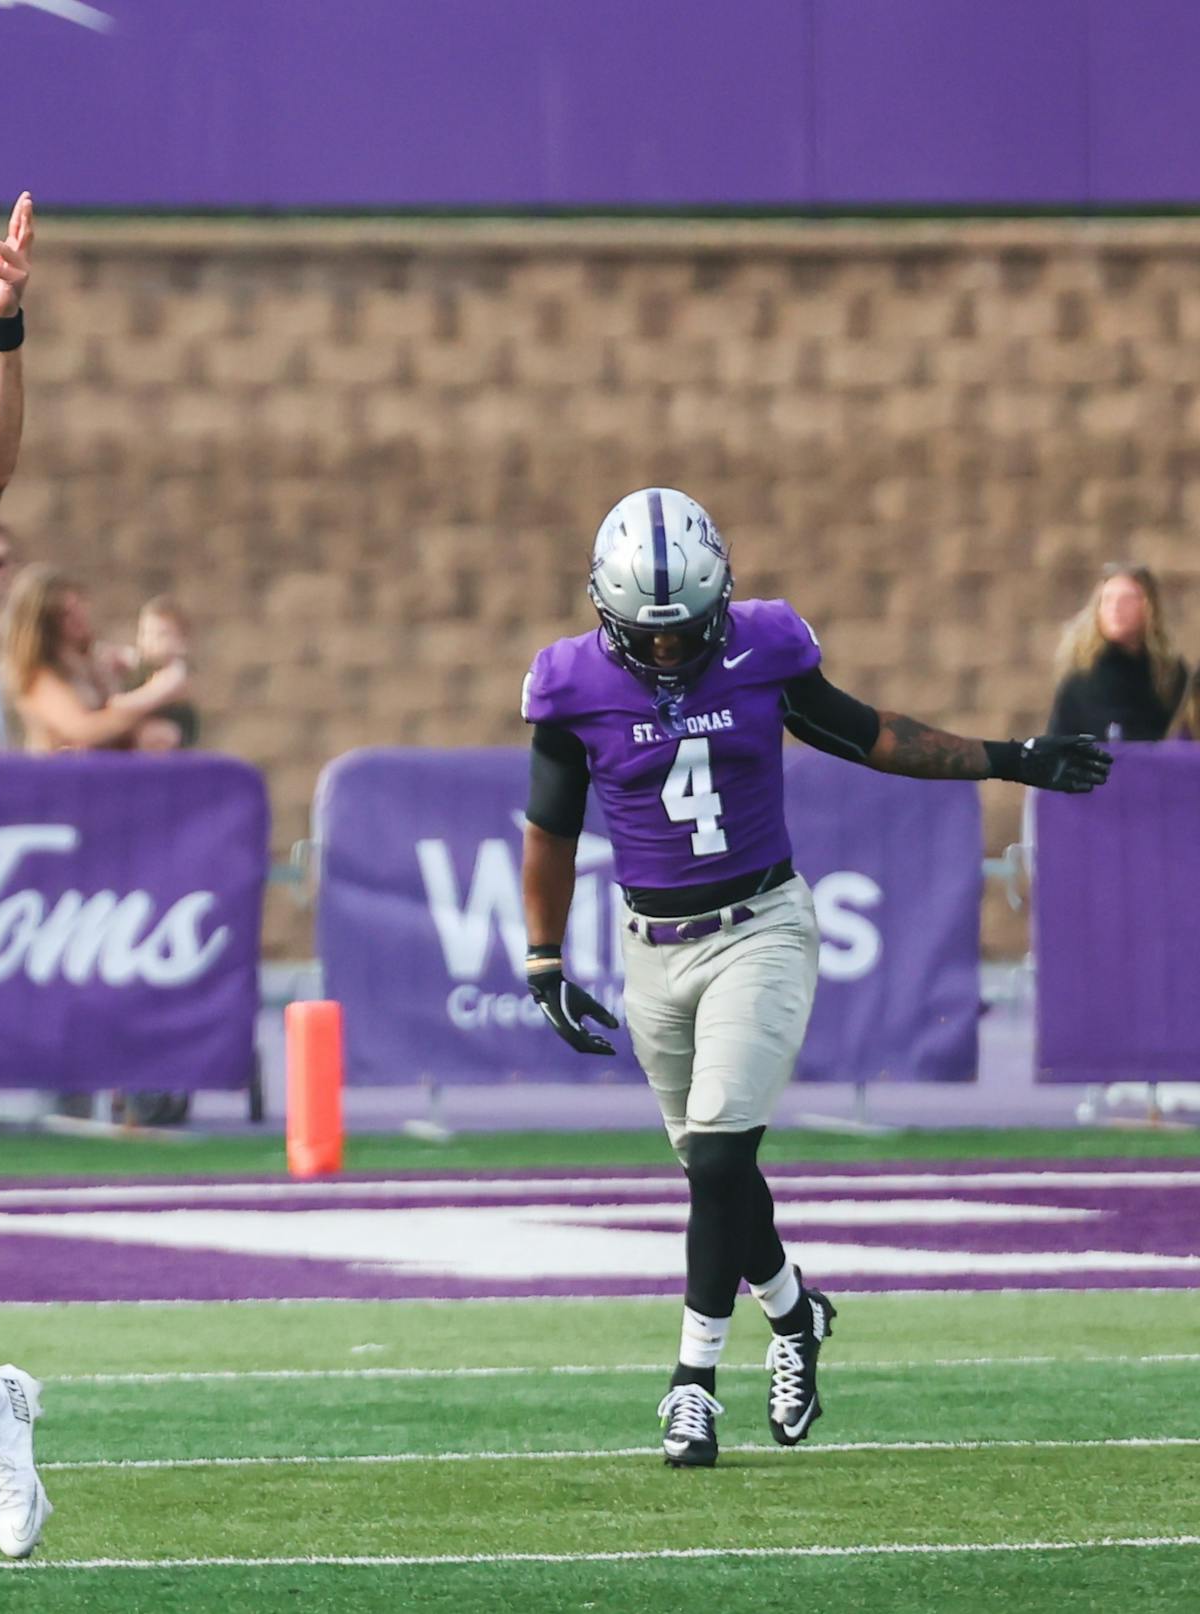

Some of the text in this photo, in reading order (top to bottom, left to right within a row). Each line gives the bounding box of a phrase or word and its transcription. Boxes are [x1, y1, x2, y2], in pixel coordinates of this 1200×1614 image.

[633, 709, 734, 743] ST. OMAS
[660, 736, 729, 857] 4
[416, 838, 883, 982] Wis
